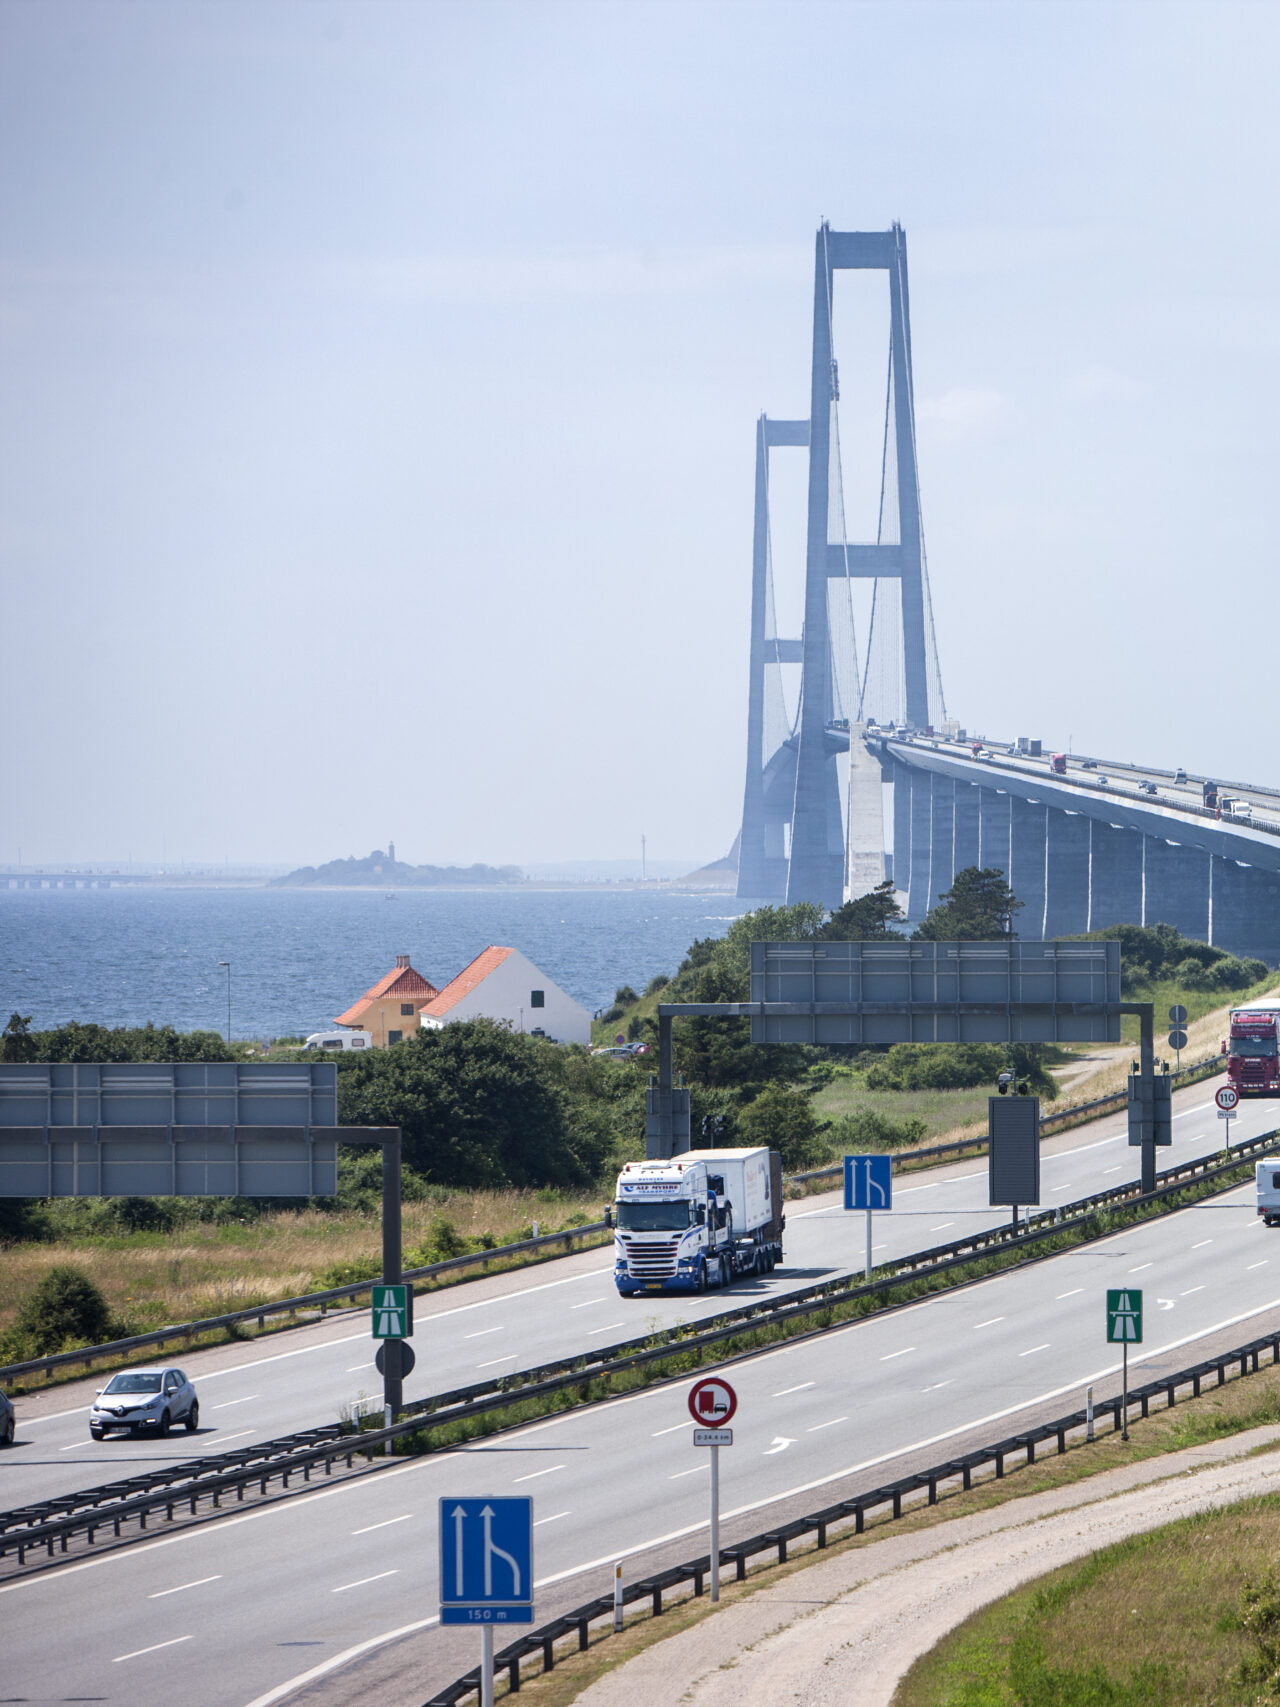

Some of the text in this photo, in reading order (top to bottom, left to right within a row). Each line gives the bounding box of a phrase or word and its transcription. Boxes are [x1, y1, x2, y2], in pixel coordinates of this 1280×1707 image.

[1220, 1093, 1235, 1102] 110
[468, 1610, 507, 1620] 150 m
